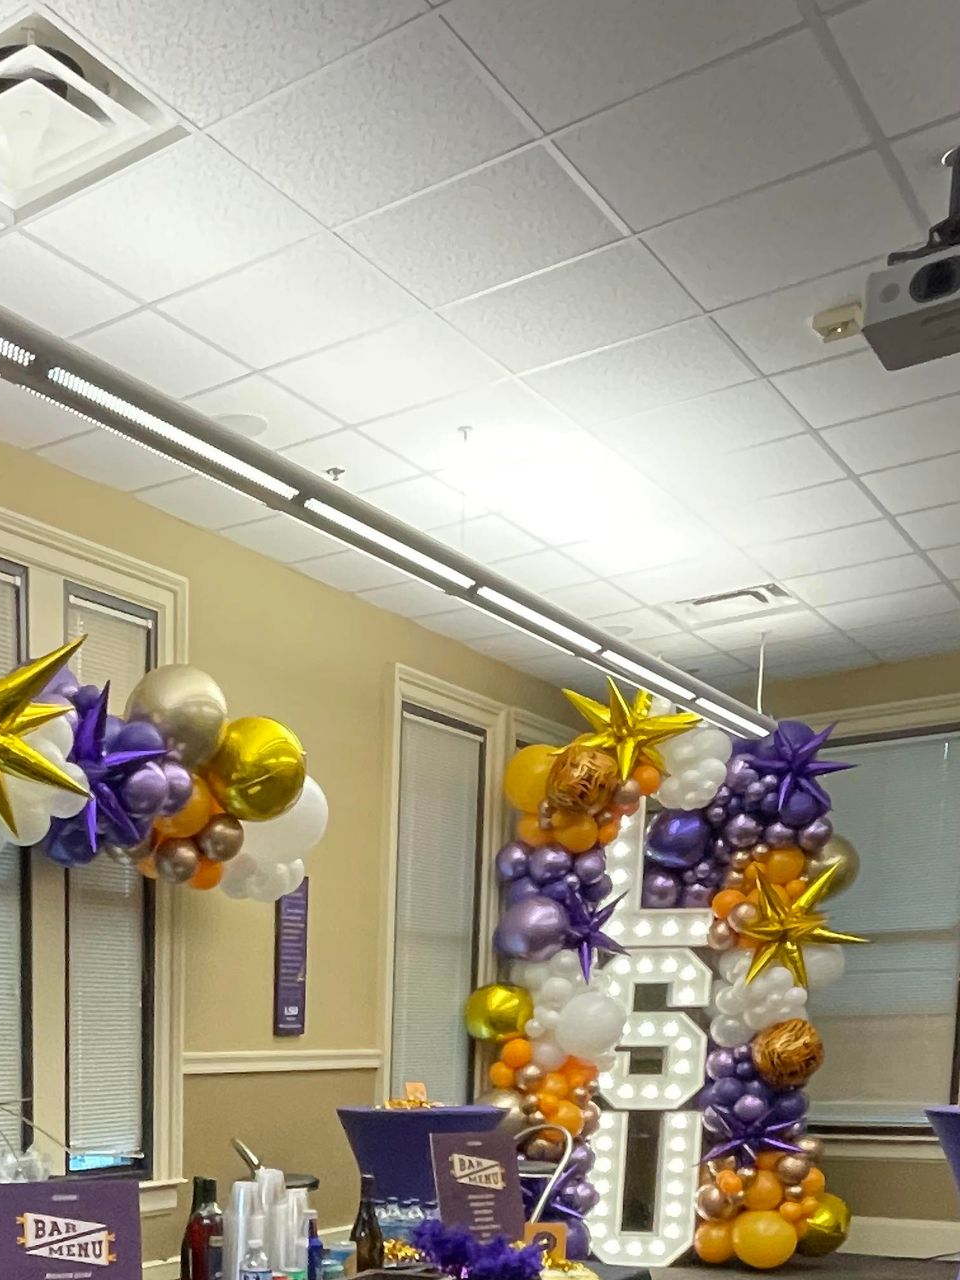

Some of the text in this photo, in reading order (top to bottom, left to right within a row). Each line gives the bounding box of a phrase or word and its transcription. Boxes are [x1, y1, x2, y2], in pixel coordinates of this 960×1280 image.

[587, 796, 713, 1267] LSU
[459, 1158, 483, 1172] BAR
[468, 1172, 499, 1185] MENU
[33, 1218, 77, 1239] BAR
[48, 1240, 103, 1259] MENU
